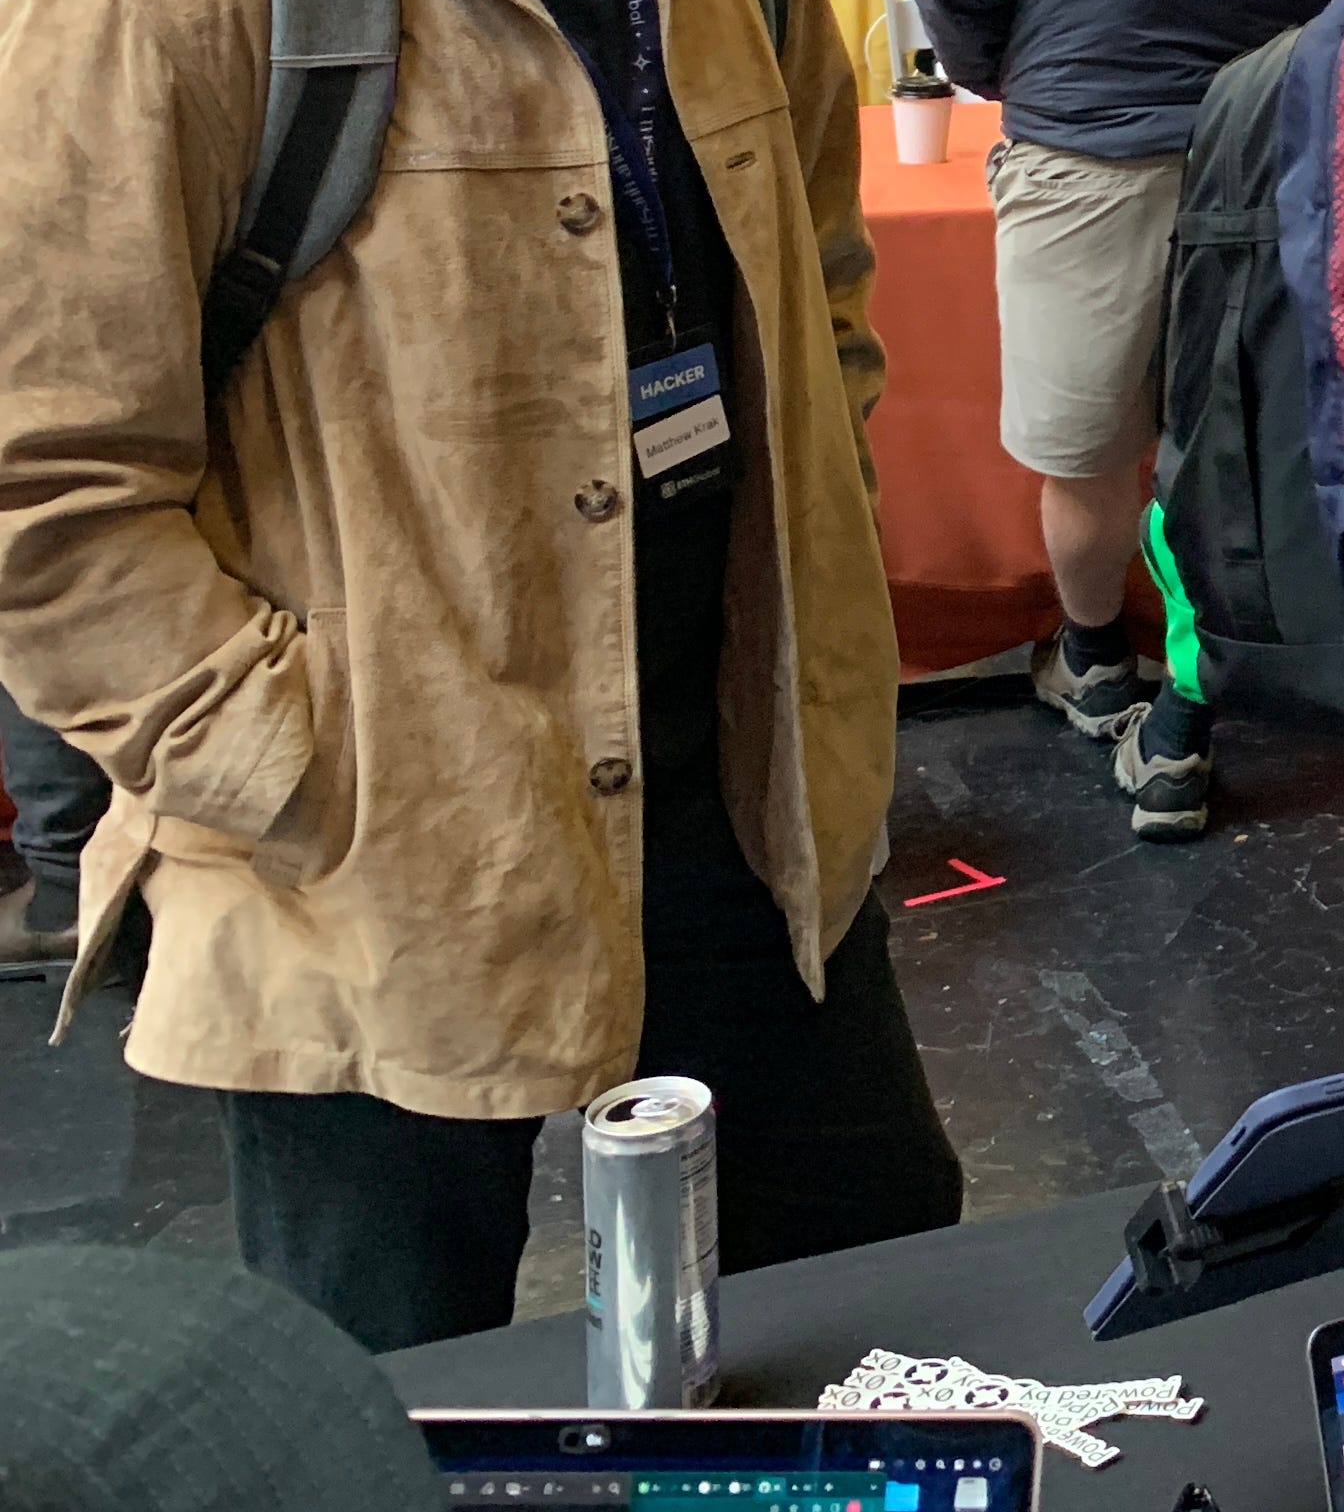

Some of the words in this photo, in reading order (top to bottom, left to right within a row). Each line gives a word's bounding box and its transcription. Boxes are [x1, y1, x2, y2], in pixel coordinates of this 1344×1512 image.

[641, 365, 705, 400] HACKER
[646, 431, 692, 458] Matthew
[1019, 1387, 1050, 1402] by
